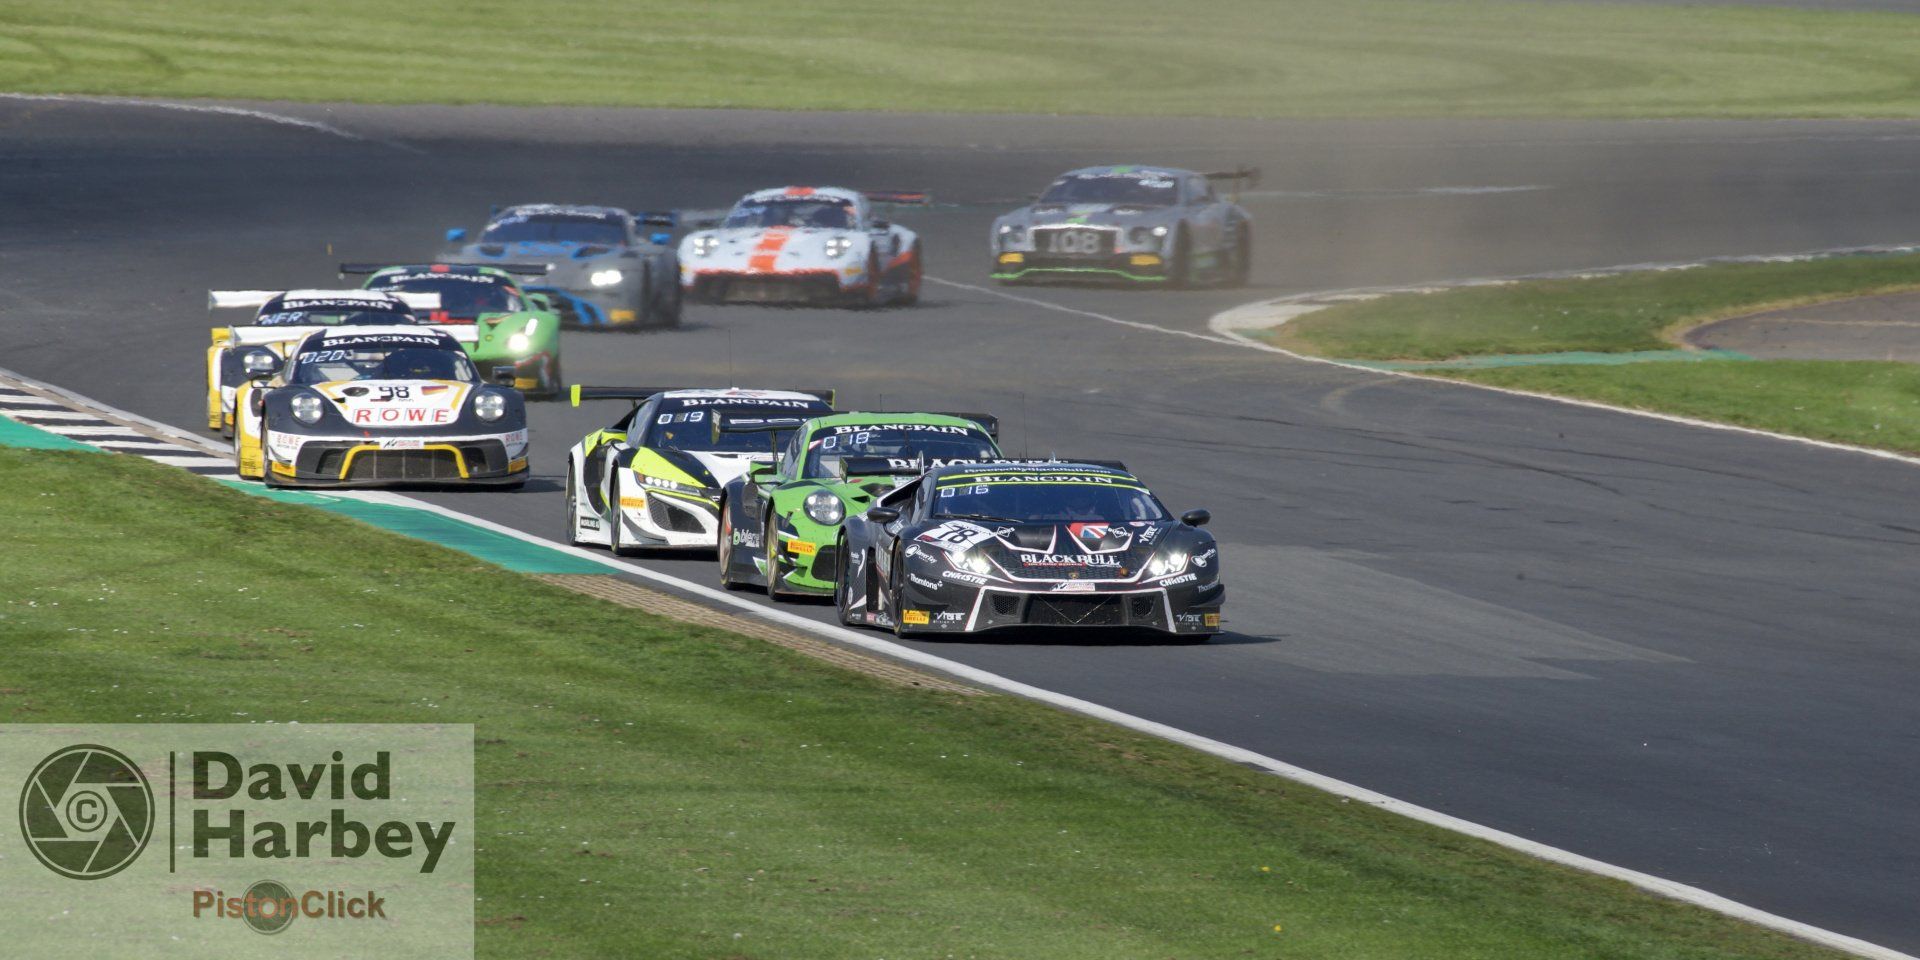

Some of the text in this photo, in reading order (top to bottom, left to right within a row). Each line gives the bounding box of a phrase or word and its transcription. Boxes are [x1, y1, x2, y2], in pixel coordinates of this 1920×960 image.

[282, 300, 393, 310] BLANCPAIN
[323, 335, 440, 347] BLANCPAIN
[379, 386, 410, 399] 98
[682, 398, 809, 409] BLANCPAIN
[355, 409, 449, 423] ROWE
[834, 424, 968, 436] BLANCPAIN
[974, 475, 1112, 484] BLANCPAIN
[937, 525, 979, 543] 78
[1020, 554, 1078, 564] BLACK
[942, 570, 988, 585] CHRISTIE
[1159, 573, 1198, 587] CHRISTIE
